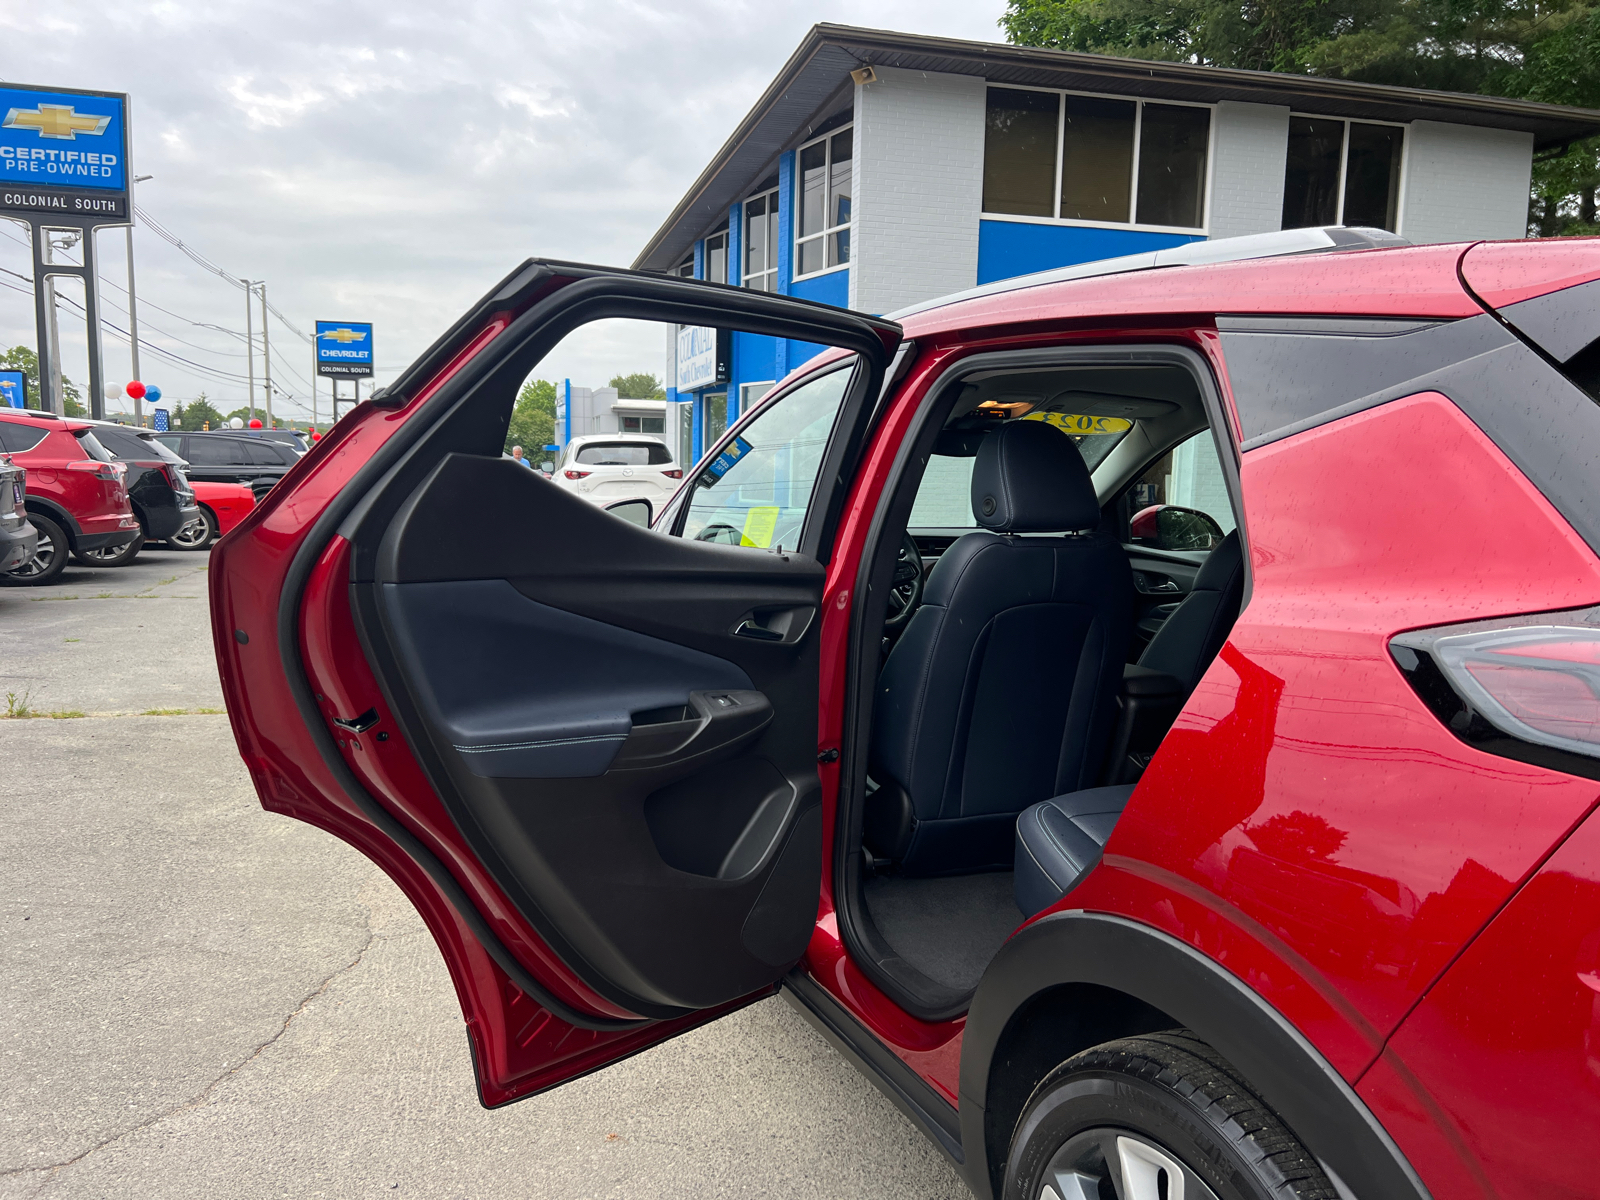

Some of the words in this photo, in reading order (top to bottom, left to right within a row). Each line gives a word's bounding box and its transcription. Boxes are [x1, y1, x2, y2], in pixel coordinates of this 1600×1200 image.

[0, 146, 117, 165] CERTIFIED
[6, 160, 112, 177] PRE-OWNED
[5, 194, 67, 208] COLONIAL
[75, 198, 116, 211] SOUTH
[321, 350, 369, 358] CHEVROLET
